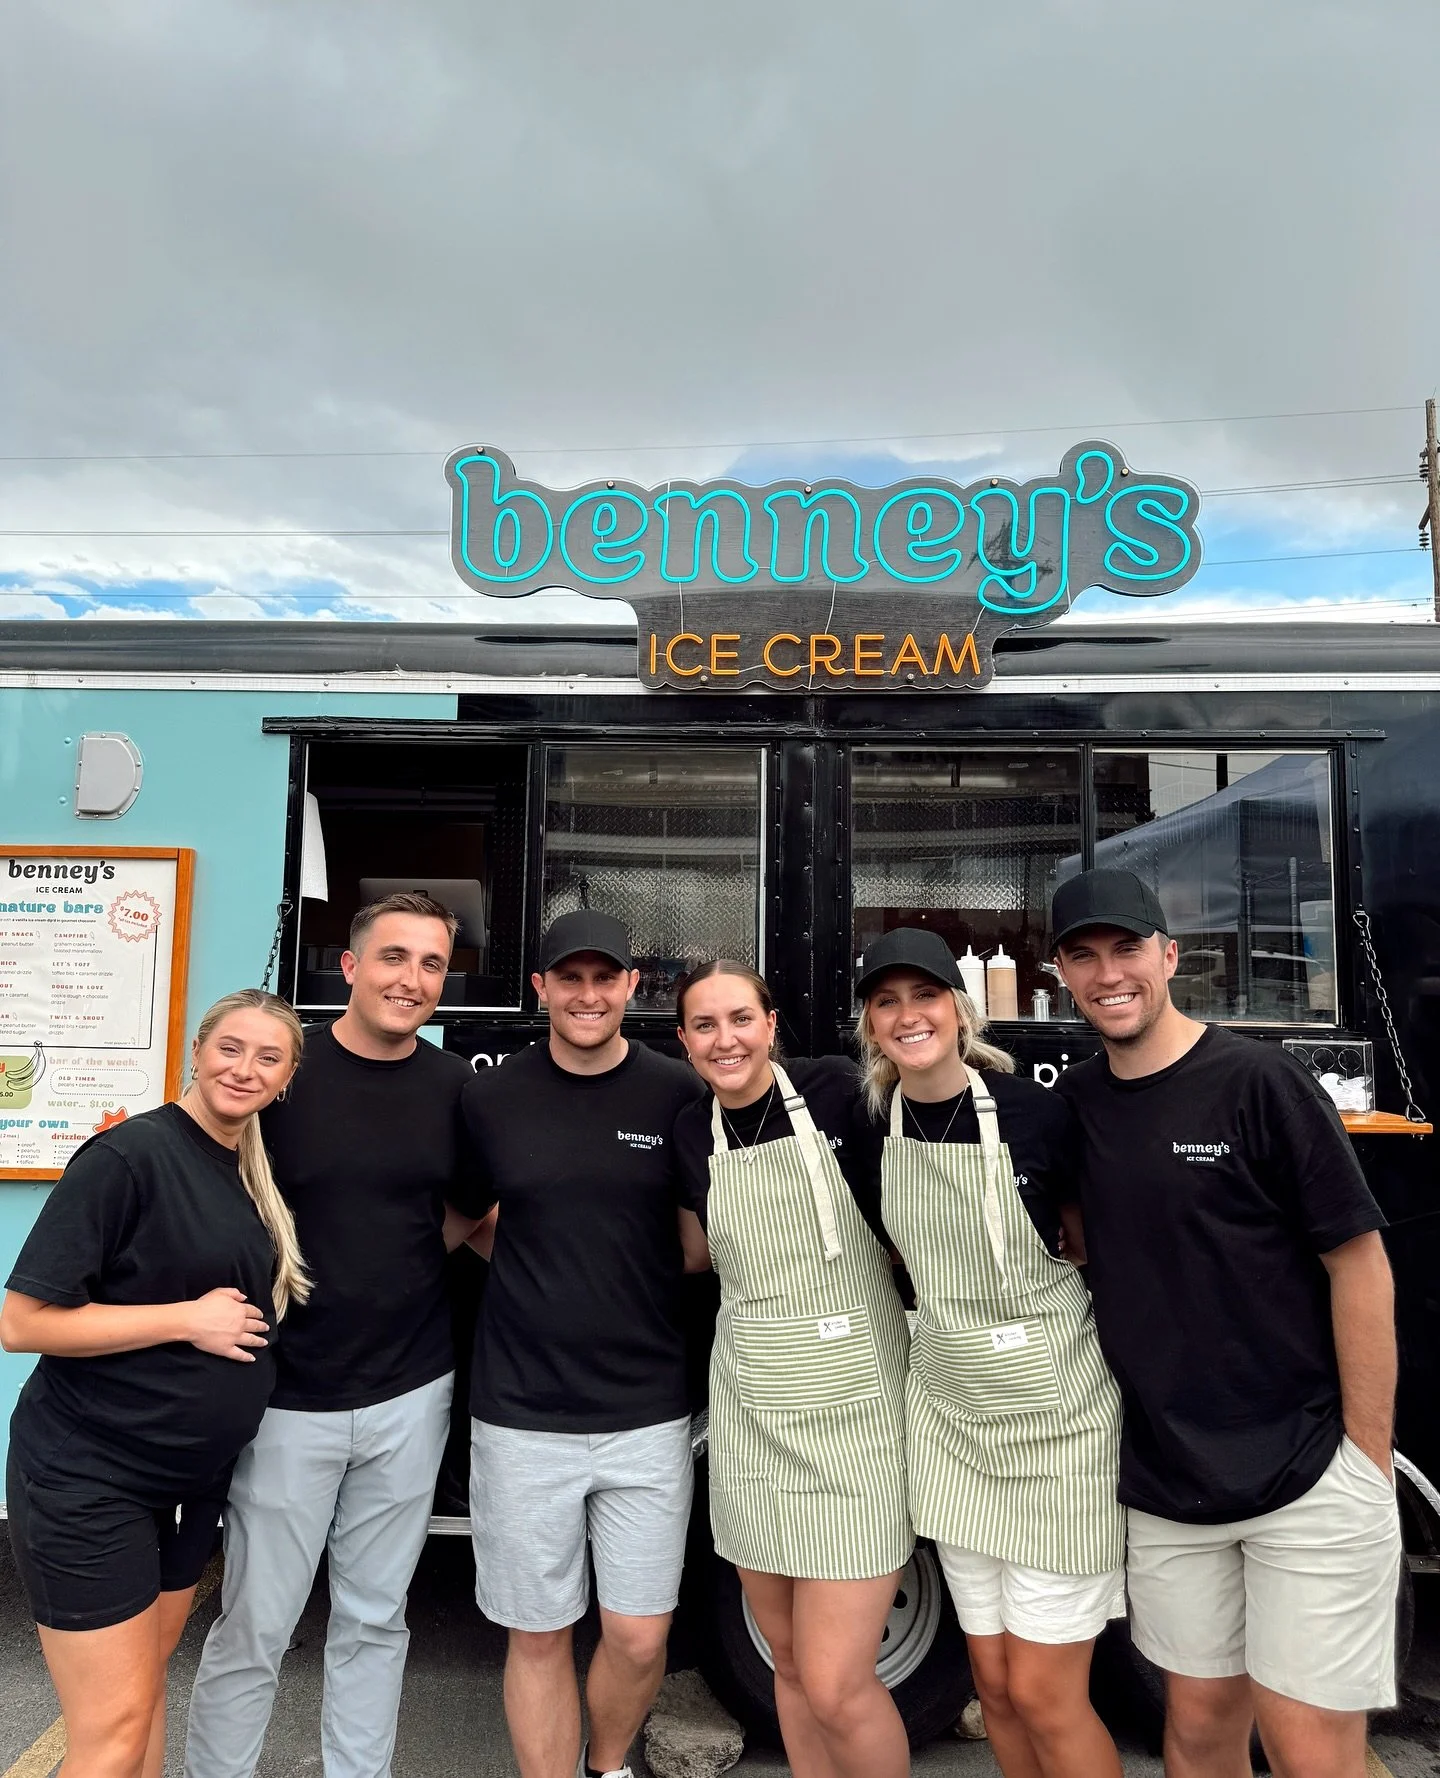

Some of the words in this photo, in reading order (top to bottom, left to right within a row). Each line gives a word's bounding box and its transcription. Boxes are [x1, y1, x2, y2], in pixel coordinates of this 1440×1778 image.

[453, 450, 1193, 613] benney's
[650, 633, 741, 677] ICE
[764, 633, 980, 677] CREAM
[8, 859, 115, 884] benney's
[36, 886, 50, 894] ICE
[63, 901, 104, 914] bars
[120, 906, 149, 921] $7.00
[49, 1057, 68, 1065] bar
[71, 1057, 83, 1065] of
[86, 1057, 102, 1065] the
[107, 1057, 138, 1066] week:
[90, 1100, 114, 1108] $1.00
[38, 1119, 69, 1128] own
[617, 1130, 664, 1146] benney's
[1172, 1141, 1230, 1156] benney's
